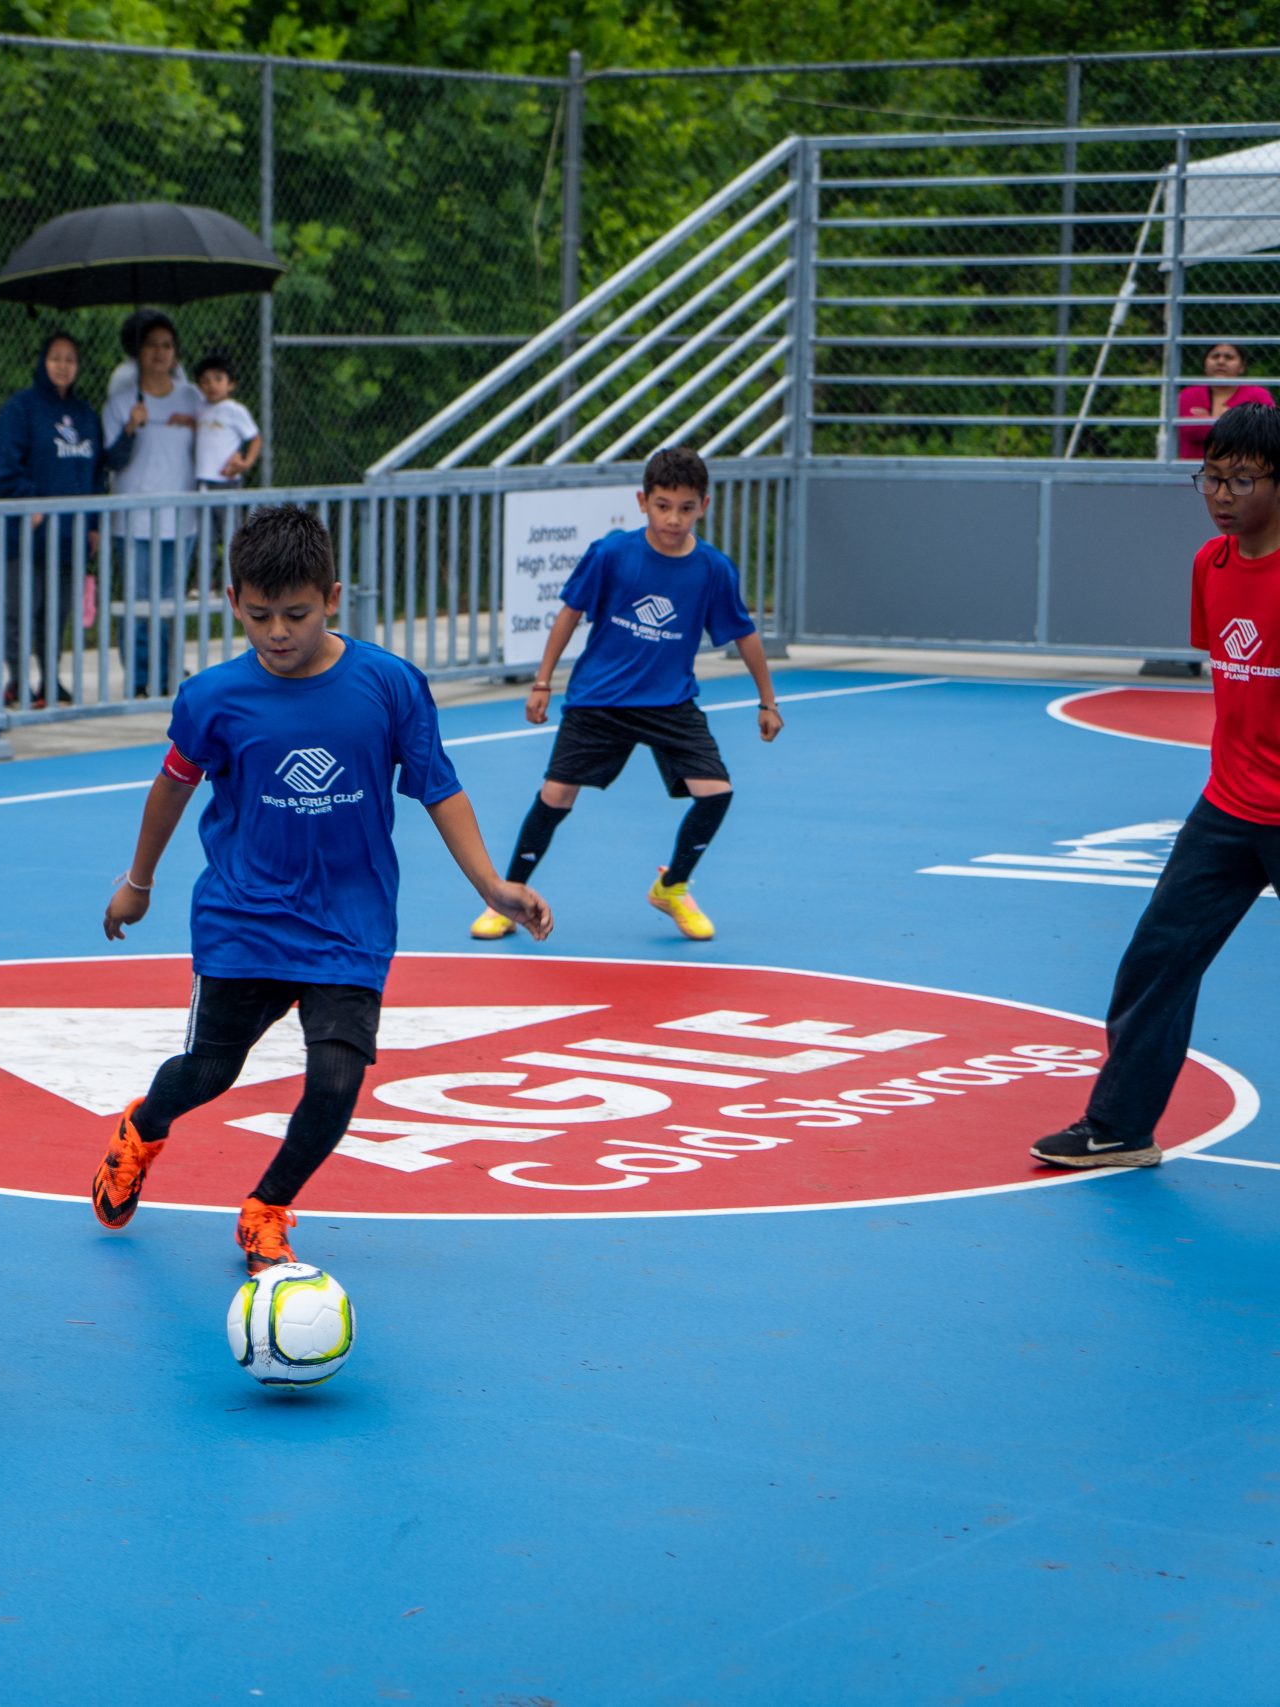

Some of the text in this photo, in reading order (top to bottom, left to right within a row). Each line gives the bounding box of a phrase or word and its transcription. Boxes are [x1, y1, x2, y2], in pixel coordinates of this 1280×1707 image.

[528, 526, 577, 544] Johnson
[517, 555, 545, 578] High
[512, 614, 541, 633] State
[223, 1009, 948, 1173] AGILE
[487, 1043, 1104, 1191] Cold Storage
